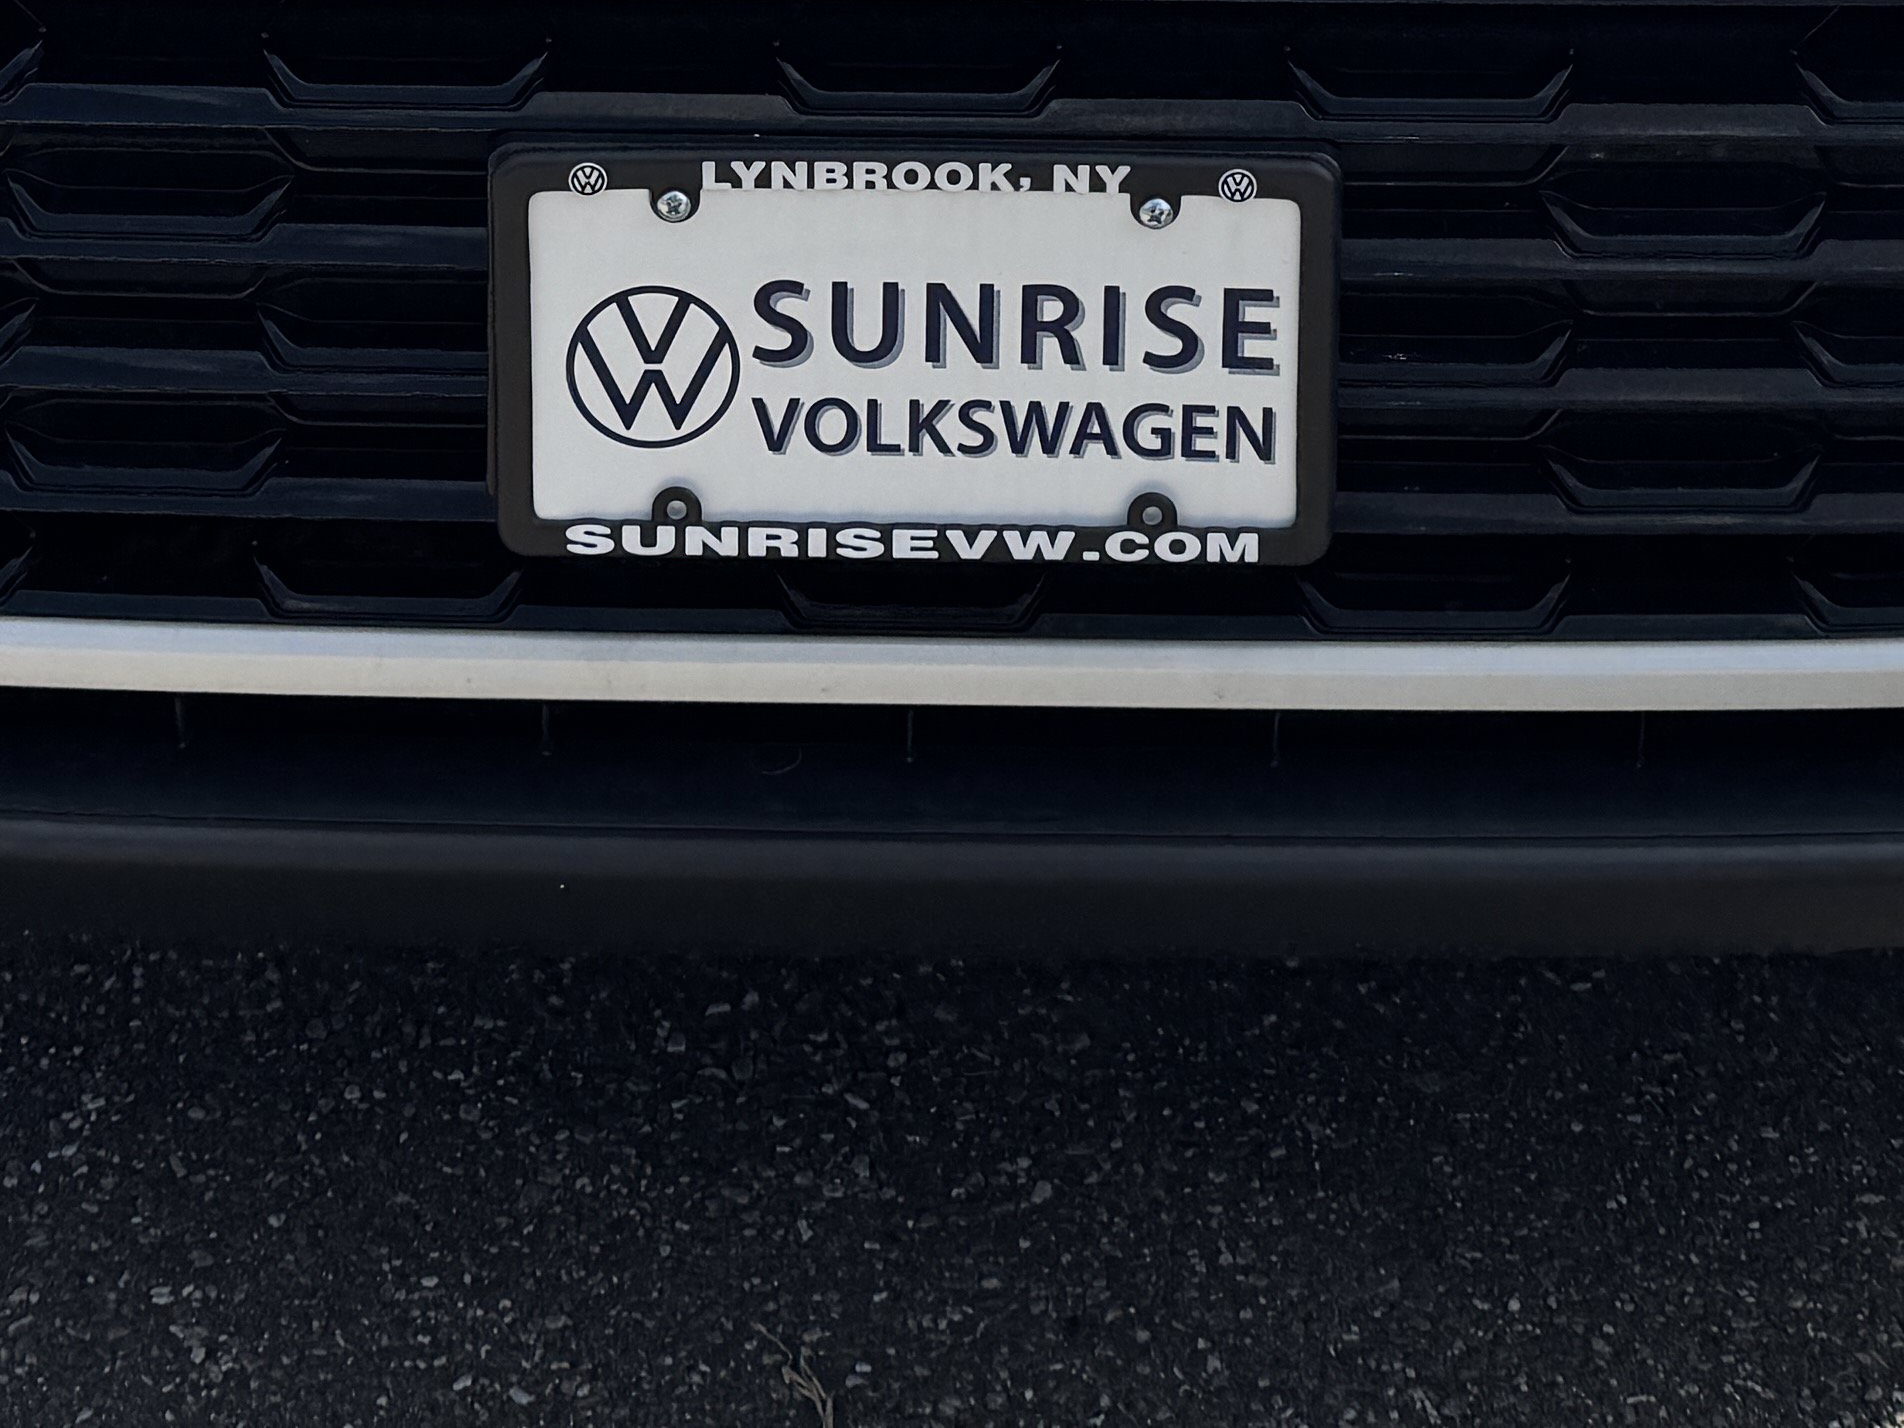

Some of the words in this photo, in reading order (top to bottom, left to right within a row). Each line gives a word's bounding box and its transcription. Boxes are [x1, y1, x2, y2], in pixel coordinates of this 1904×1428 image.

[701, 160, 1032, 193] LYNBROOK,
[1052, 163, 1132, 195] NY
[751, 279, 1281, 376] SUNRISE
[751, 396, 1277, 465] VOLKSWAGEN
[564, 524, 1261, 564] SUNRISEVW.COM
